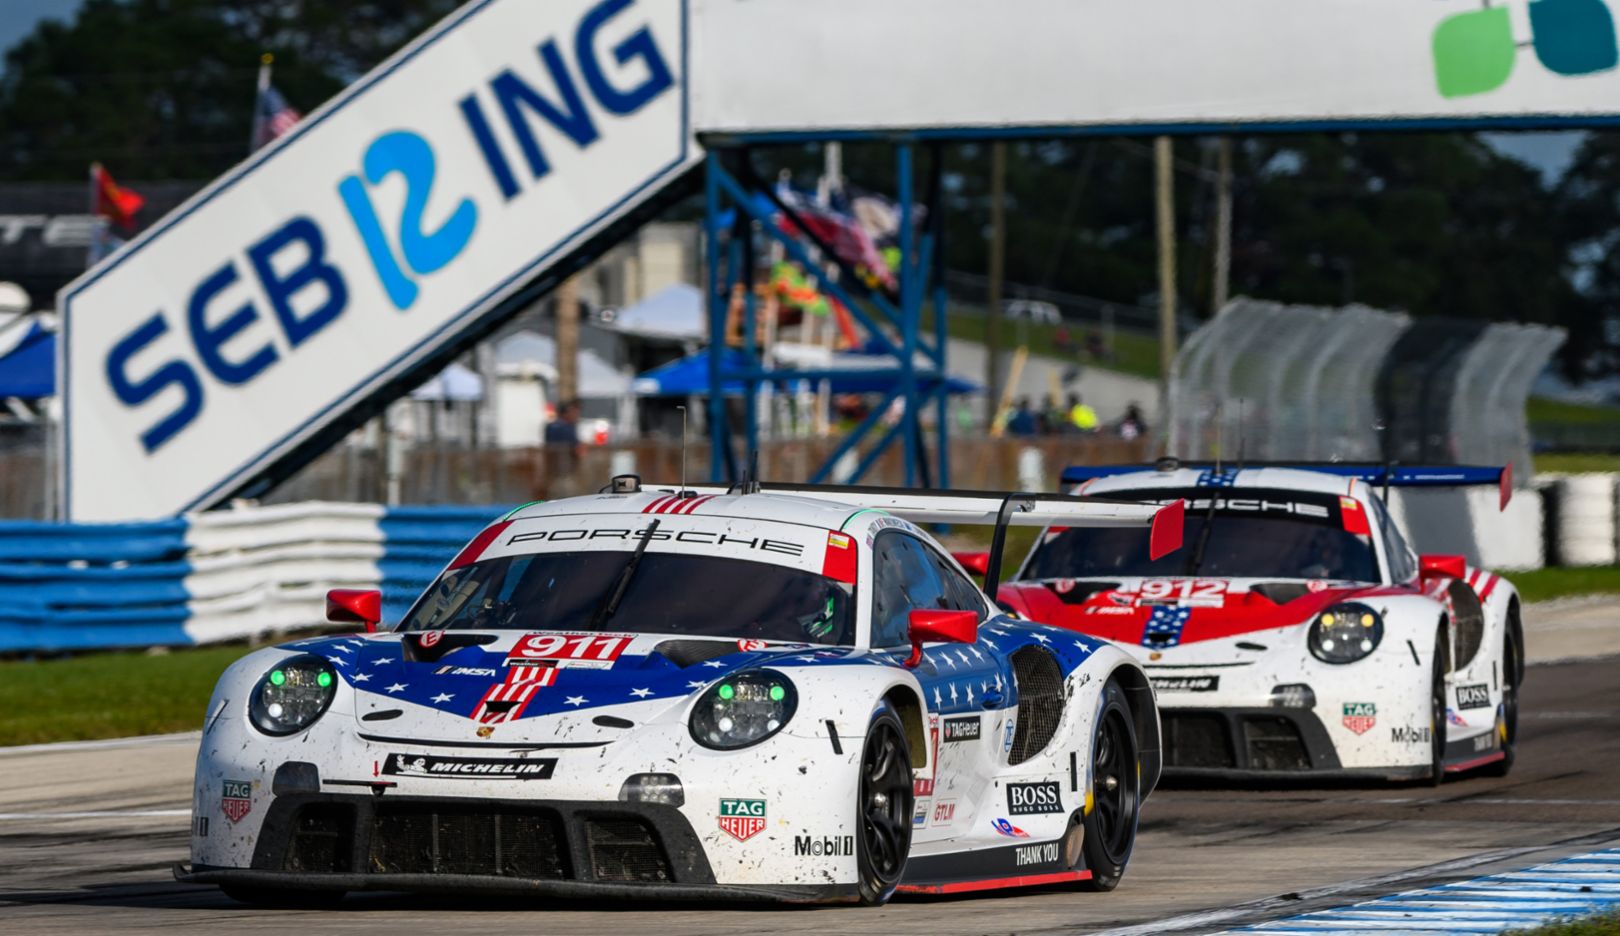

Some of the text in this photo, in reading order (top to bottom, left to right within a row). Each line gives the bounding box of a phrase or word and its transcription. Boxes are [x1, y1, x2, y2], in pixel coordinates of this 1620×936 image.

[506, 528, 805, 556] PORSCHE
[1141, 580, 1226, 597] 912
[521, 635, 623, 659] 911
[1459, 688, 1487, 704] BOSS
[1345, 703, 1374, 715] TAG
[430, 761, 545, 774] MICHELIN
[225, 784, 249, 797] TAG
[1011, 786, 1057, 806] BOSS
[223, 801, 249, 820] HEUER
[723, 801, 763, 815] TAG
[934, 803, 955, 821] GTLM
[721, 817, 764, 839] HEUER
[795, 836, 854, 856] Mobil 1
[1016, 843, 1060, 866] THANK YOU
